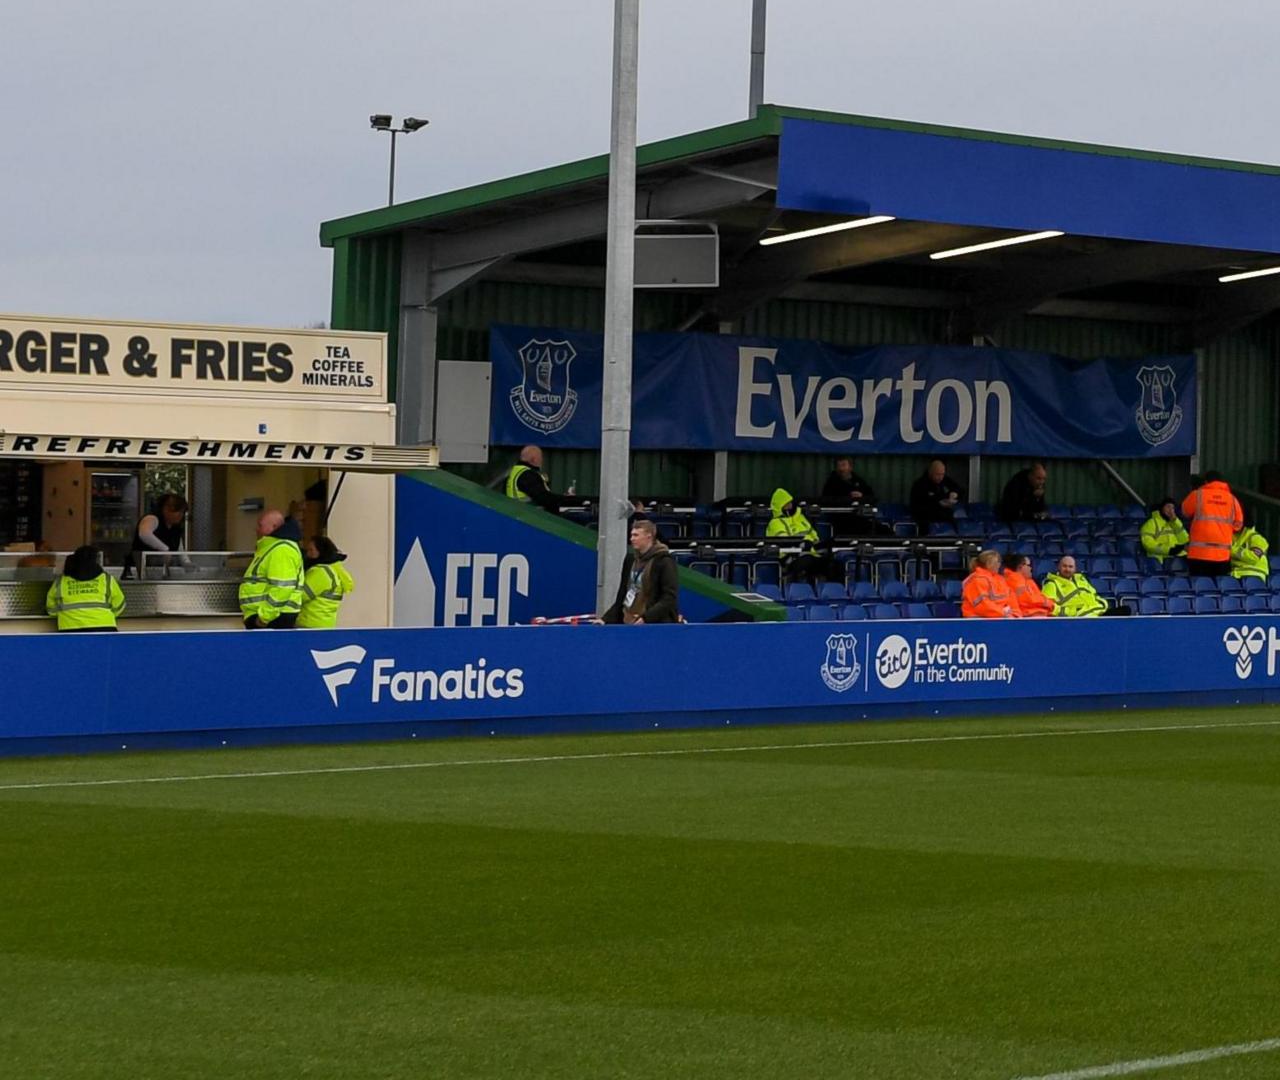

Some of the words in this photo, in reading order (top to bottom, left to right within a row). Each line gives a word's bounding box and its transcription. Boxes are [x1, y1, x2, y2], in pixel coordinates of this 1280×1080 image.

[122, 335, 158, 378] &
[170, 337, 294, 383] FRIES
[325, 345, 351, 360] TEA
[311, 358, 365, 375] COFFEE
[302, 371, 374, 388] MINERALS
[530, 390, 561, 404] Everton
[734, 346, 1012, 444] Everton
[12, 435, 366, 461] REFRESHMENTS
[914, 637, 988, 665] Everton
[371, 658, 525, 703] Fanatics
[914, 666, 924, 683] in
[927, 666, 946, 683] the
[949, 664, 1014, 684] Community
